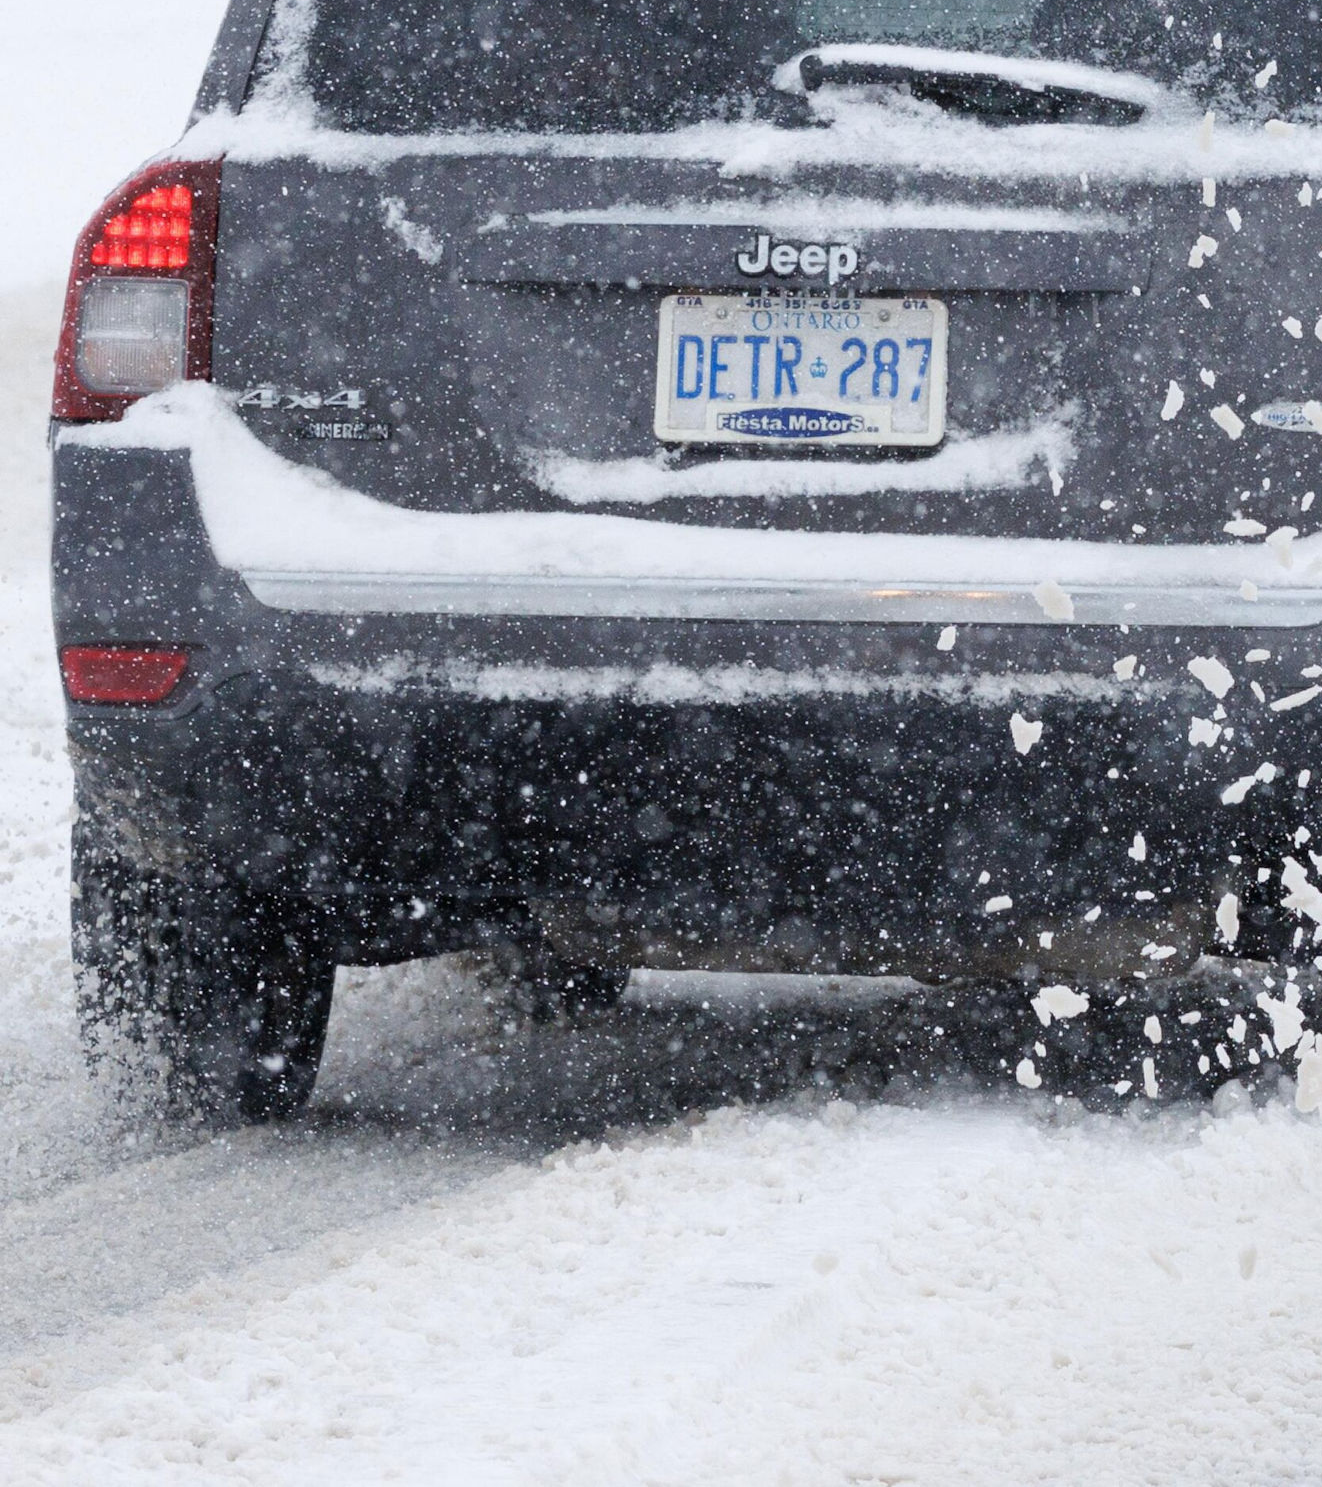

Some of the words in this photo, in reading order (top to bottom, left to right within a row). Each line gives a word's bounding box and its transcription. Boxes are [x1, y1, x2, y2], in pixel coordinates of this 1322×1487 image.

[737, 234, 859, 284] Jeep
[677, 296, 703, 306] GTA
[902, 300, 929, 310] GTA
[752, 310, 861, 332] ONTARIO
[238, 388, 367, 410] 4x4
[716, 411, 784, 431] Fiesta
